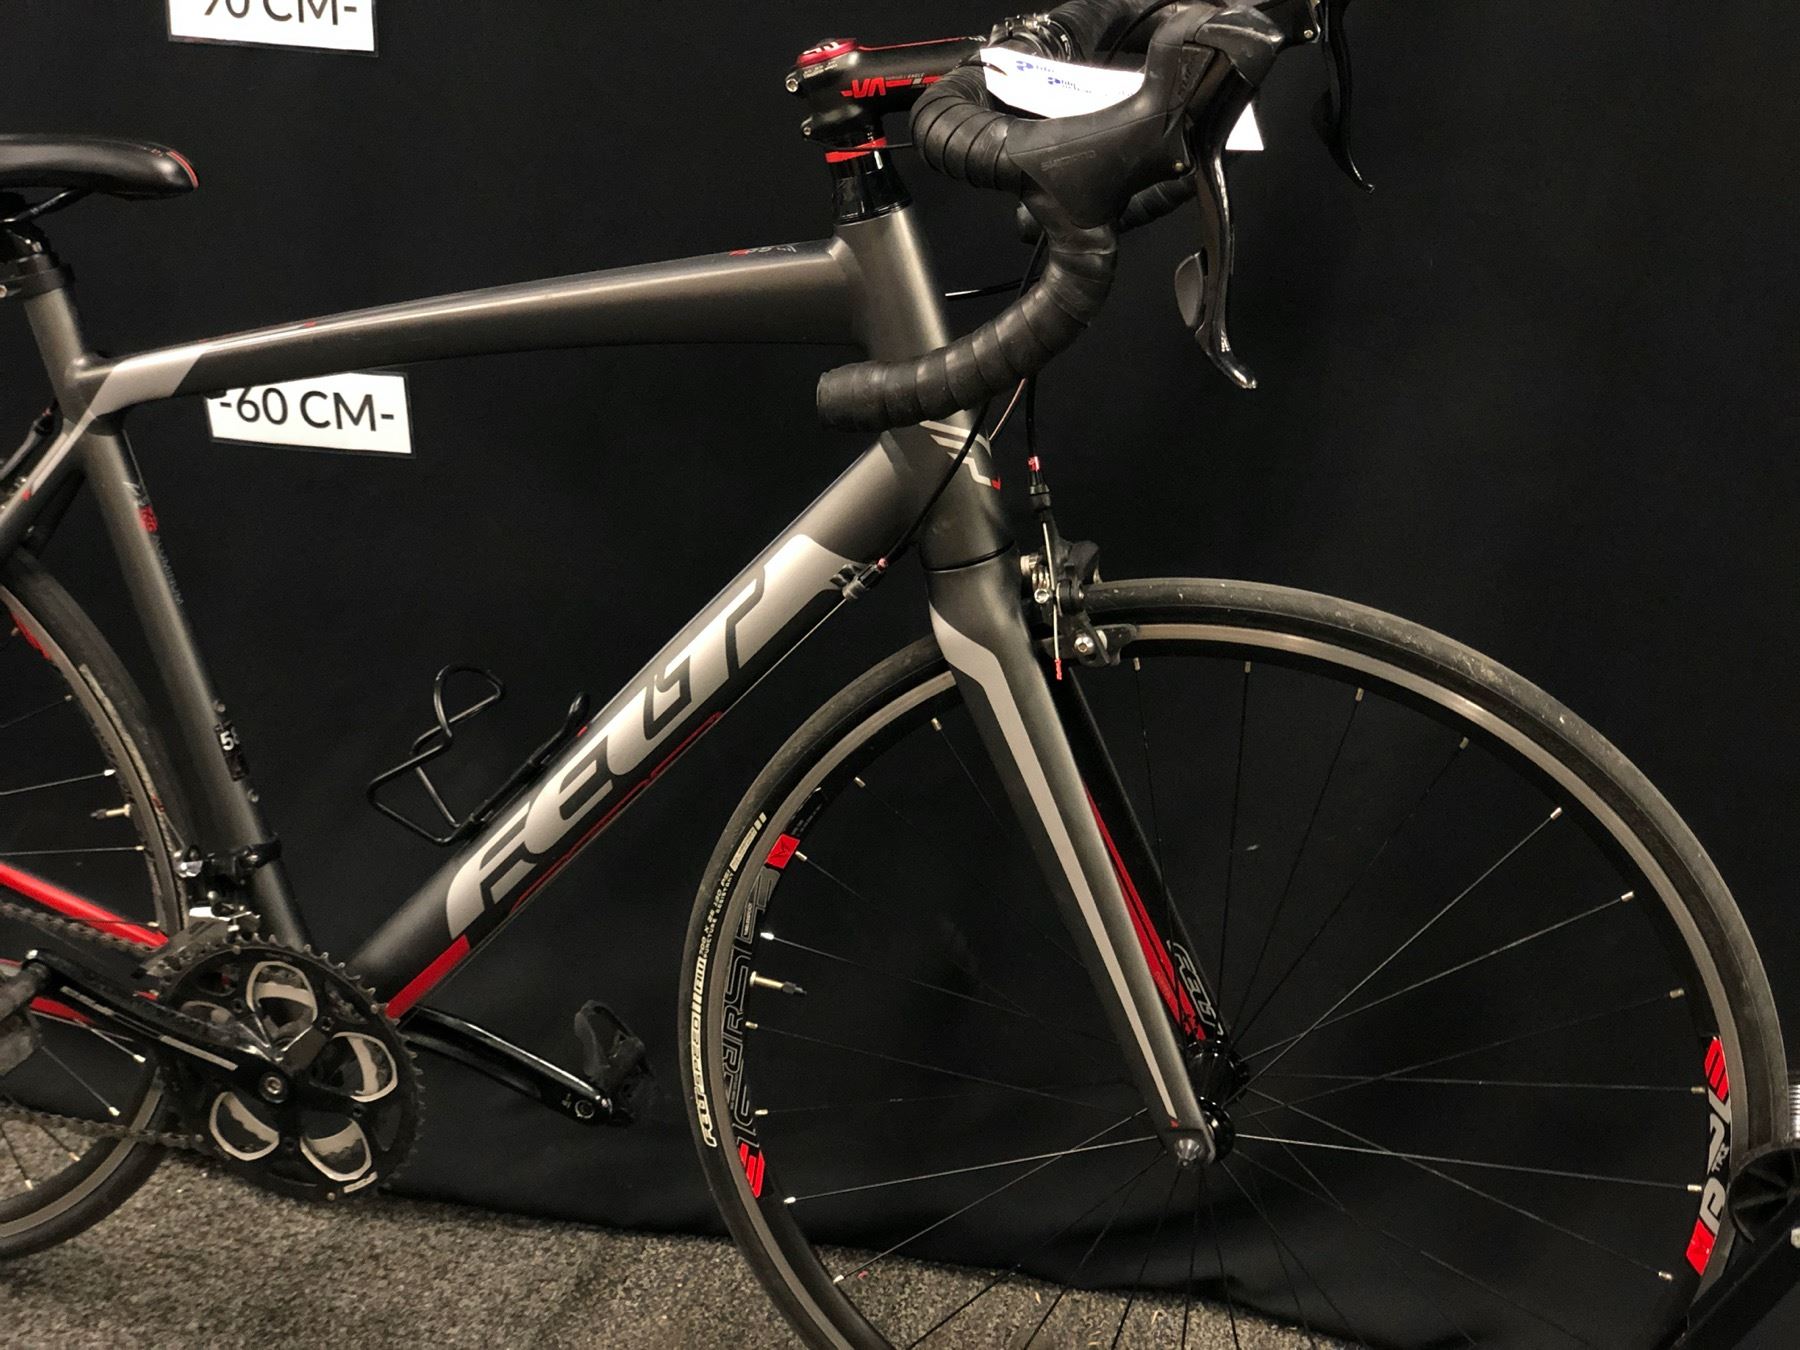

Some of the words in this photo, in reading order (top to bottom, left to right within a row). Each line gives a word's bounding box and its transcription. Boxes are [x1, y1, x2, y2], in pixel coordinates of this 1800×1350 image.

[220, 387, 288, 425] -60
[300, 391, 394, 431] CM-
[446, 578, 758, 940] FELT
[1166, 940, 1224, 1036] FELT
[691, 1011, 705, 1092] SPEED
[694, 1089, 717, 1148] FELT
